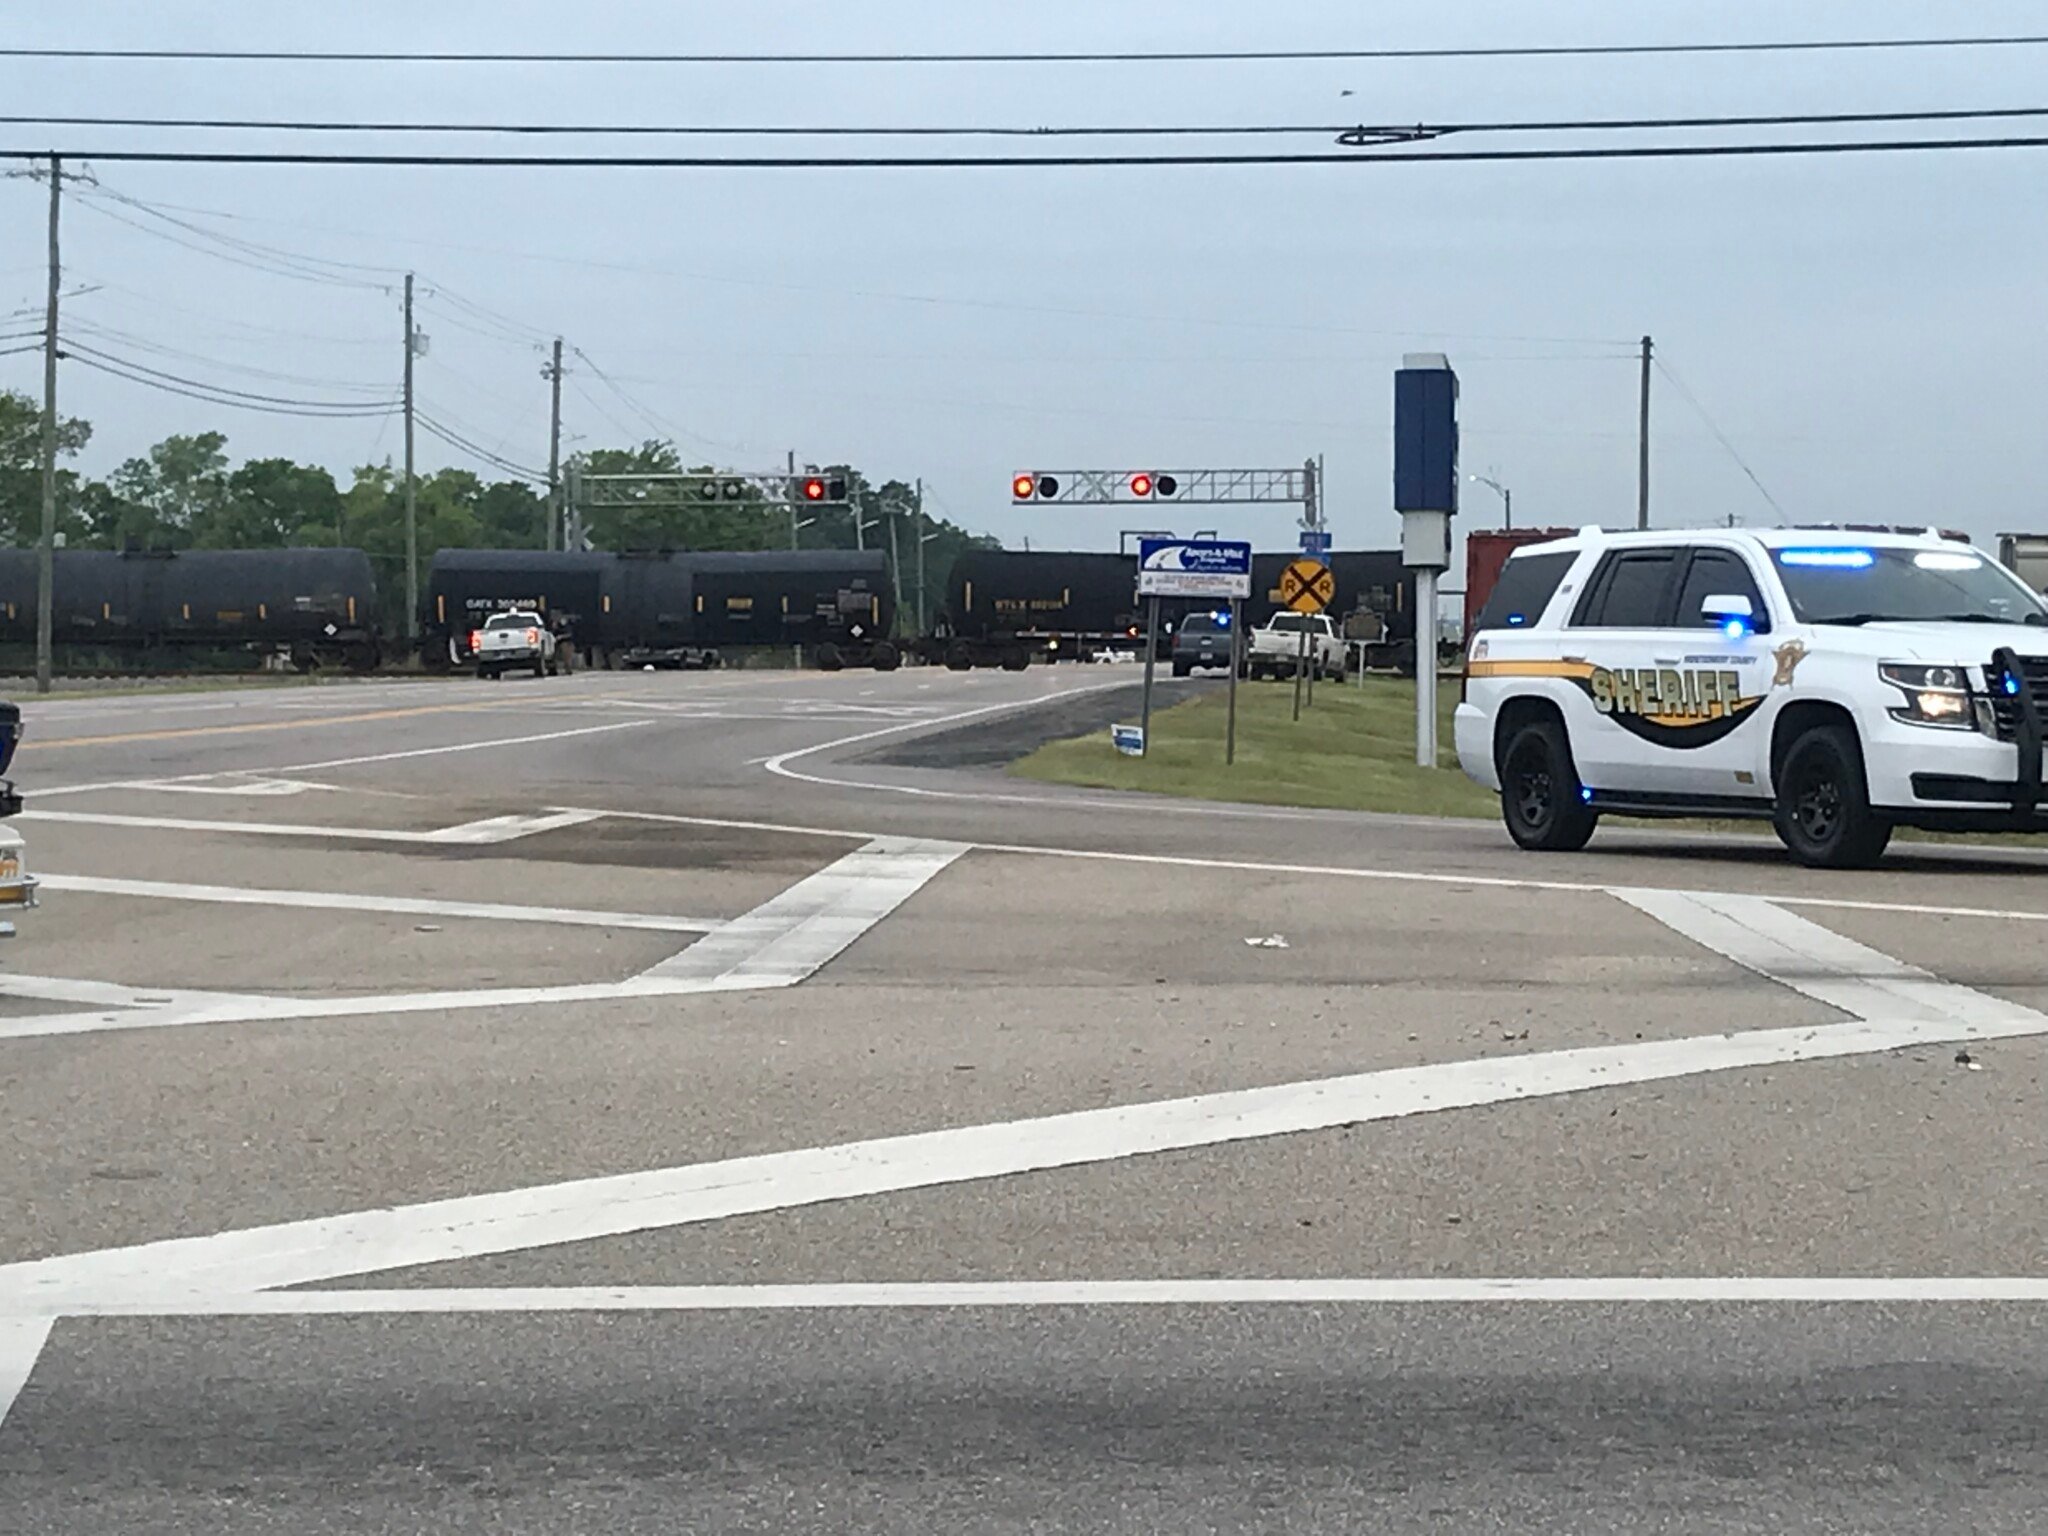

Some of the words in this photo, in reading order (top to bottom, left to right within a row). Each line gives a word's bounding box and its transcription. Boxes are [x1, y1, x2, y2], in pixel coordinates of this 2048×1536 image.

[1284, 579, 1296, 593] R
[1319, 579, 1331, 594] R
[1591, 667, 1740, 717] SHERIFF
